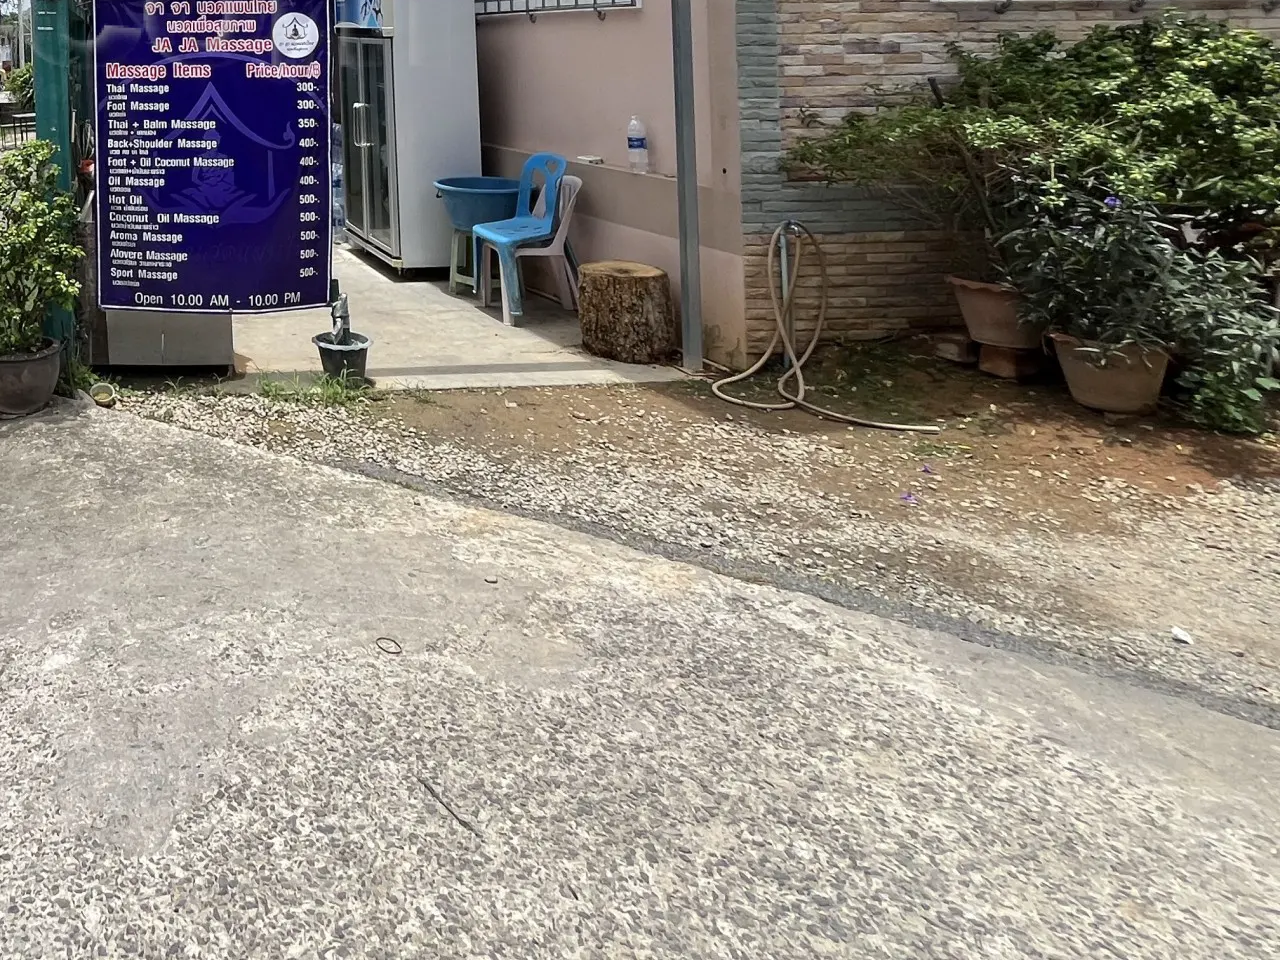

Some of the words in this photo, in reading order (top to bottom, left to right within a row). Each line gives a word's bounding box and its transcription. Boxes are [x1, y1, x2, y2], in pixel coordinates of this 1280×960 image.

[145, 1, 164, 15] จา
[170, 1, 190, 15] จา
[151, 38, 172, 53] JA
[178, 38, 199, 53] JA
[205, 37, 274, 55] Massage
[106, 62, 166, 81] Massage
[172, 61, 211, 78] Items
[106, 84, 125, 93] Thai
[130, 83, 170, 94] Massage
[107, 101, 126, 111] Foot
[130, 101, 170, 112] Massage
[108, 119, 128, 129] Thai
[143, 119, 167, 129] Balm
[171, 119, 216, 130] Massage
[107, 138, 173, 149] Back+Shoulder
[177, 138, 218, 150] Massage
[108, 157, 127, 167] Foot
[140, 157, 151, 167] Oil
[154, 157, 190, 167] Coconut
[193, 156, 235, 168] Massage
[108, 176, 121, 186] Oil
[125, 176, 165, 187] Massage
[108, 194, 126, 205] Hot
[129, 195, 142, 205] Oil
[109, 211, 148, 223] Coconut
[157, 213, 170, 223] Oil
[174, 213, 220, 225] Massage
[110, 230, 138, 240] Aroma
[143, 231, 183, 244] Massage
[146, 250, 188, 262] Massage
[110, 267, 133, 279] Sport
[138, 269, 178, 281] Massage
[135, 292, 163, 306] Open
[170, 294, 203, 306] 10.00
[209, 294, 229, 307] AM
[248, 293, 278, 307] 10.00
[284, 292, 301, 304] PM
